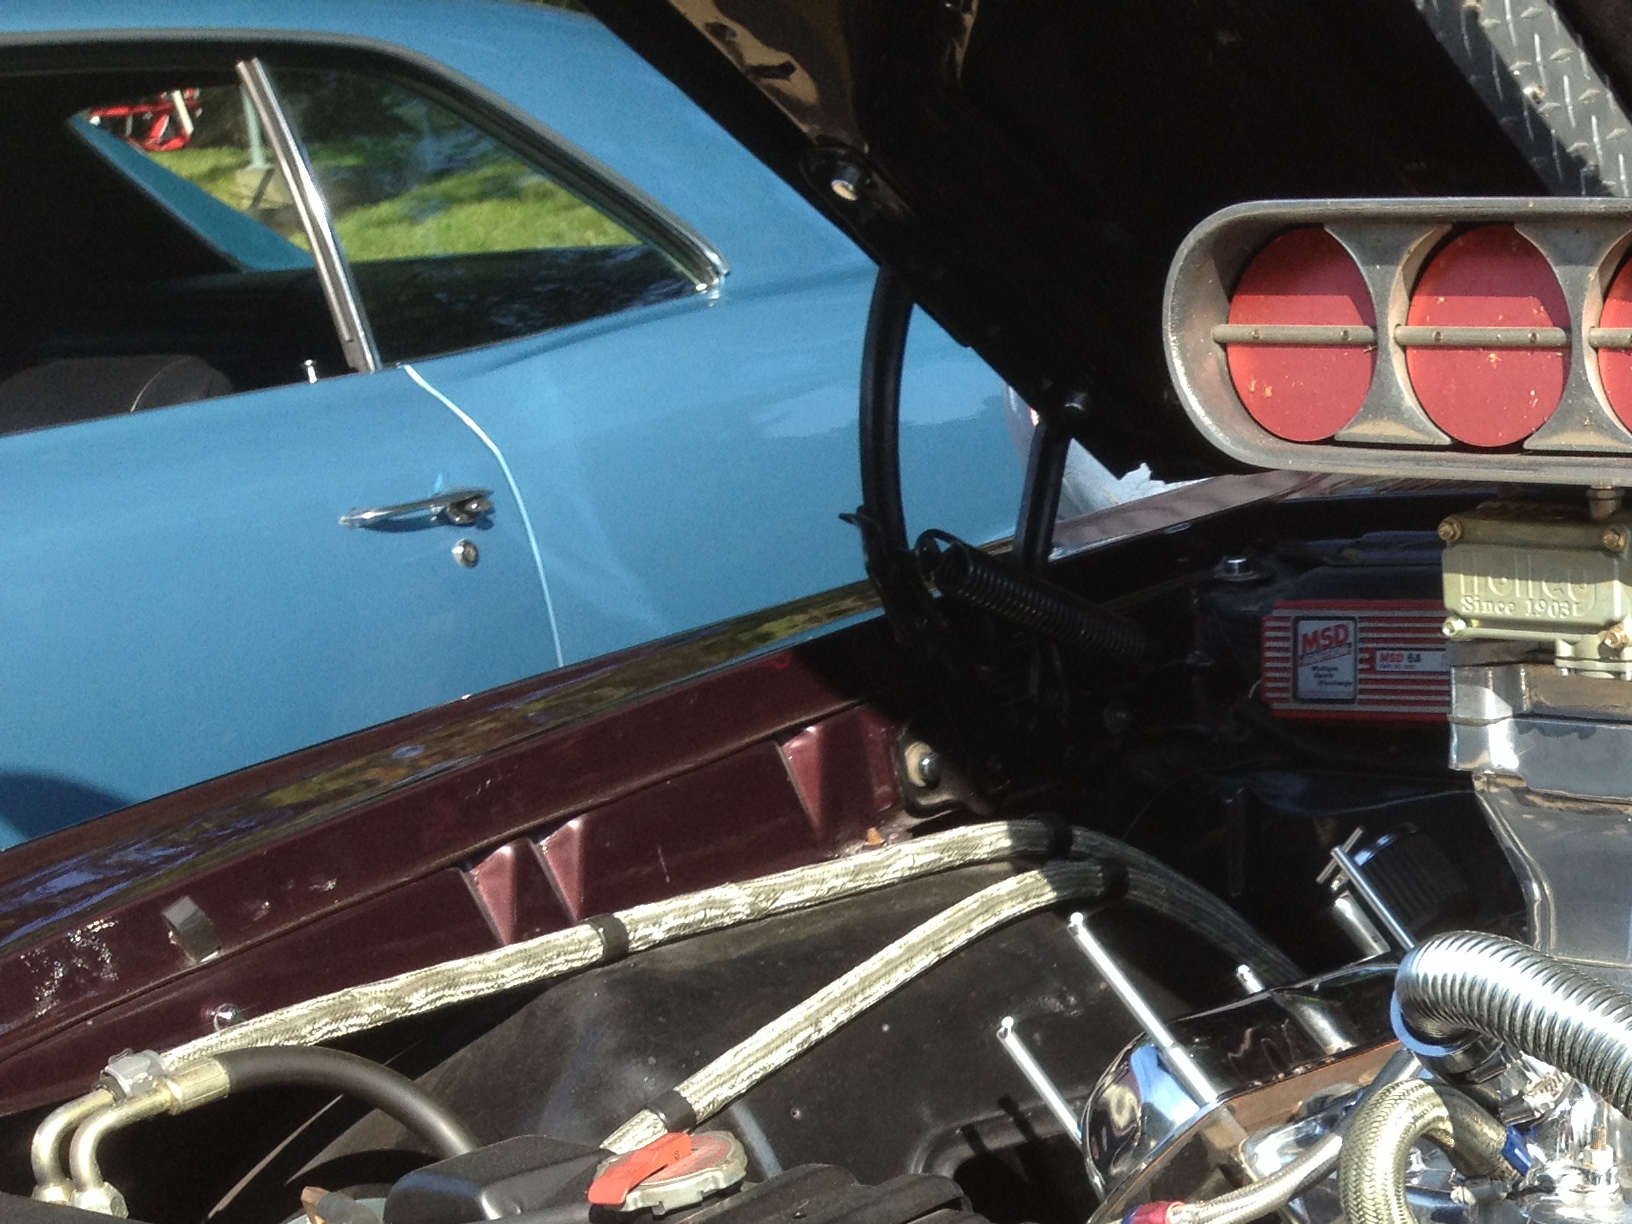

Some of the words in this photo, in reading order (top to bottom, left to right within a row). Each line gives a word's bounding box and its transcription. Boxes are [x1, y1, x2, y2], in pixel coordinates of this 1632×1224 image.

[1460, 596, 1516, 615] Since
[1524, 598, 1570, 618] 1903
[1302, 623, 1350, 653] MSD
